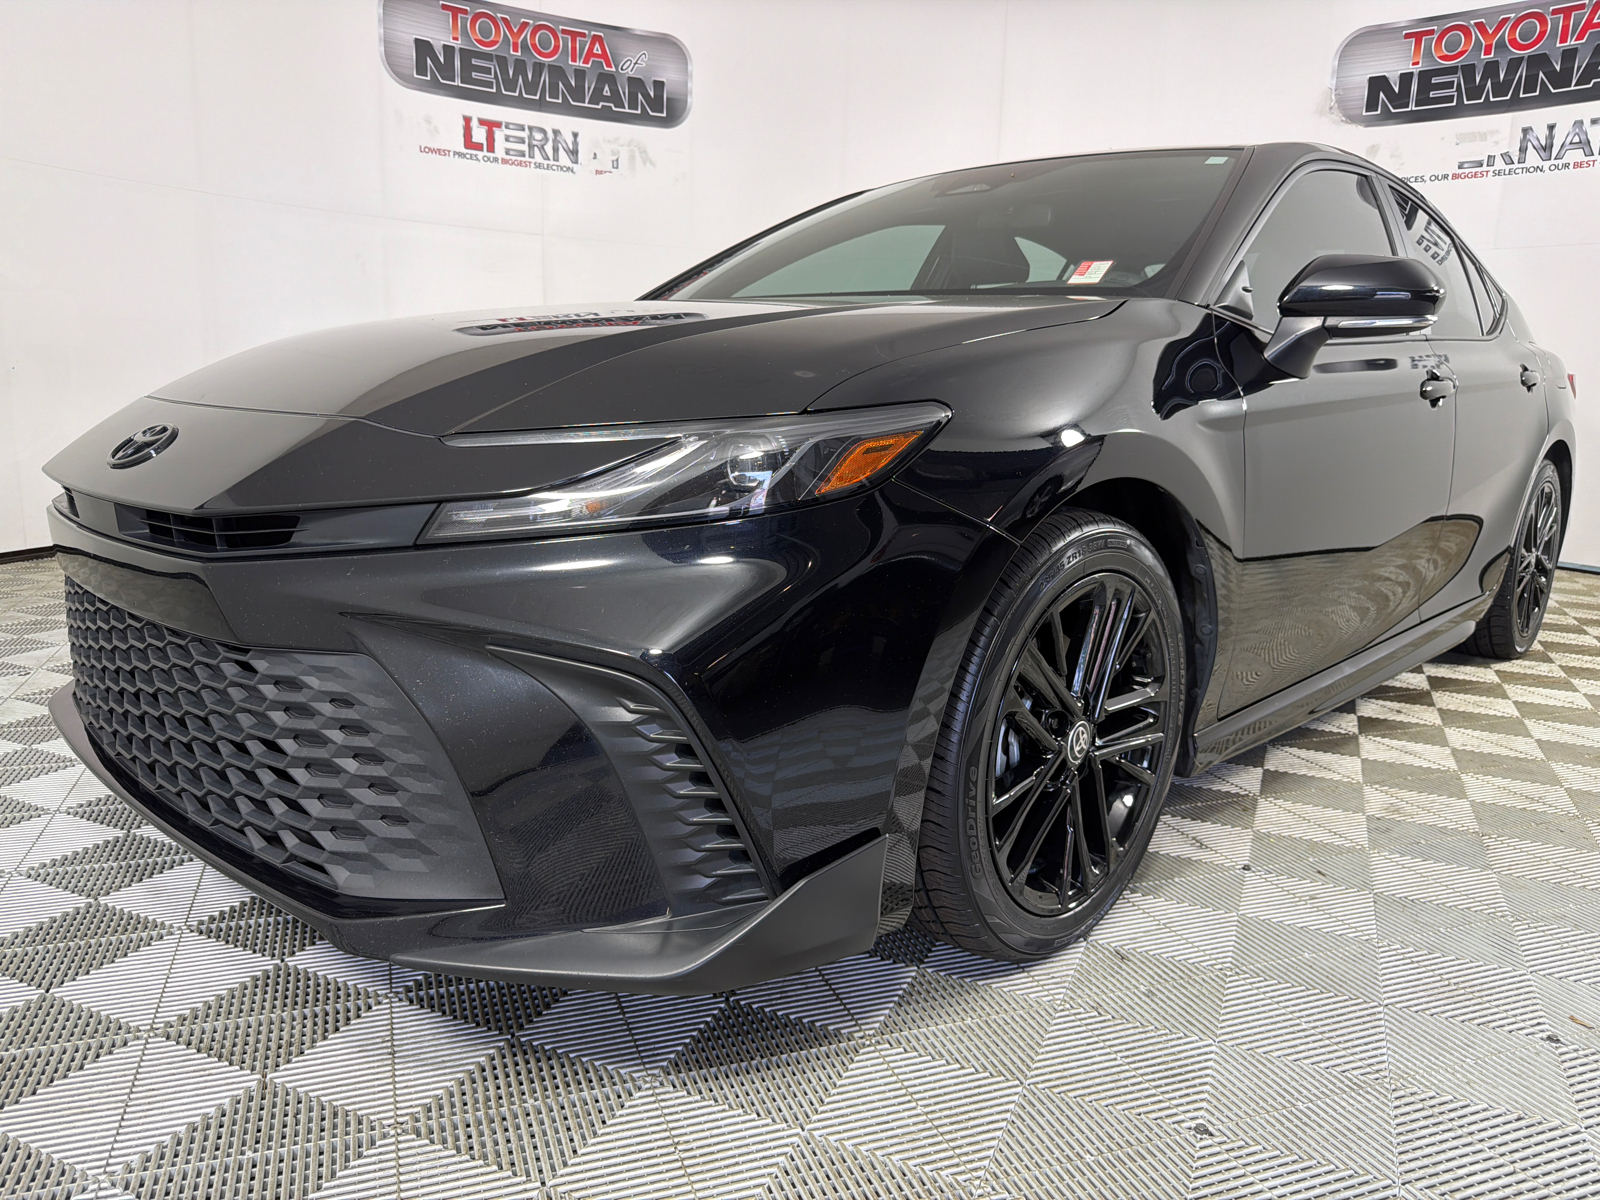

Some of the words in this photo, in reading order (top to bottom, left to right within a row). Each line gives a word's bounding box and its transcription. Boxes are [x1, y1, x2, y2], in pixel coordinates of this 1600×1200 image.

[440, 1, 615, 70] TOYOTA
[618, 51, 648, 74] of
[1403, 0, 1600, 67] TOYOTA
[413, 36, 667, 117] NEWNAN
[419, 145, 451, 157] LOWEST
[453, 151, 481, 163] PRICES,
[482, 155, 499, 165] OUR
[501, 157, 532, 168] BIGGEST
[533, 163, 576, 175] SELECTION,
[1400, 174, 1427, 184] RICES,
[1429, 173, 1450, 182] OUR
[1451, 169, 1490, 181] BIGGEST
[1491, 165, 1546, 178] SELECTION,
[1548, 162, 1571, 172] OUR
[1572, 159, 1598, 170] BEST
[965, 765, 981, 880] GeoDrive
